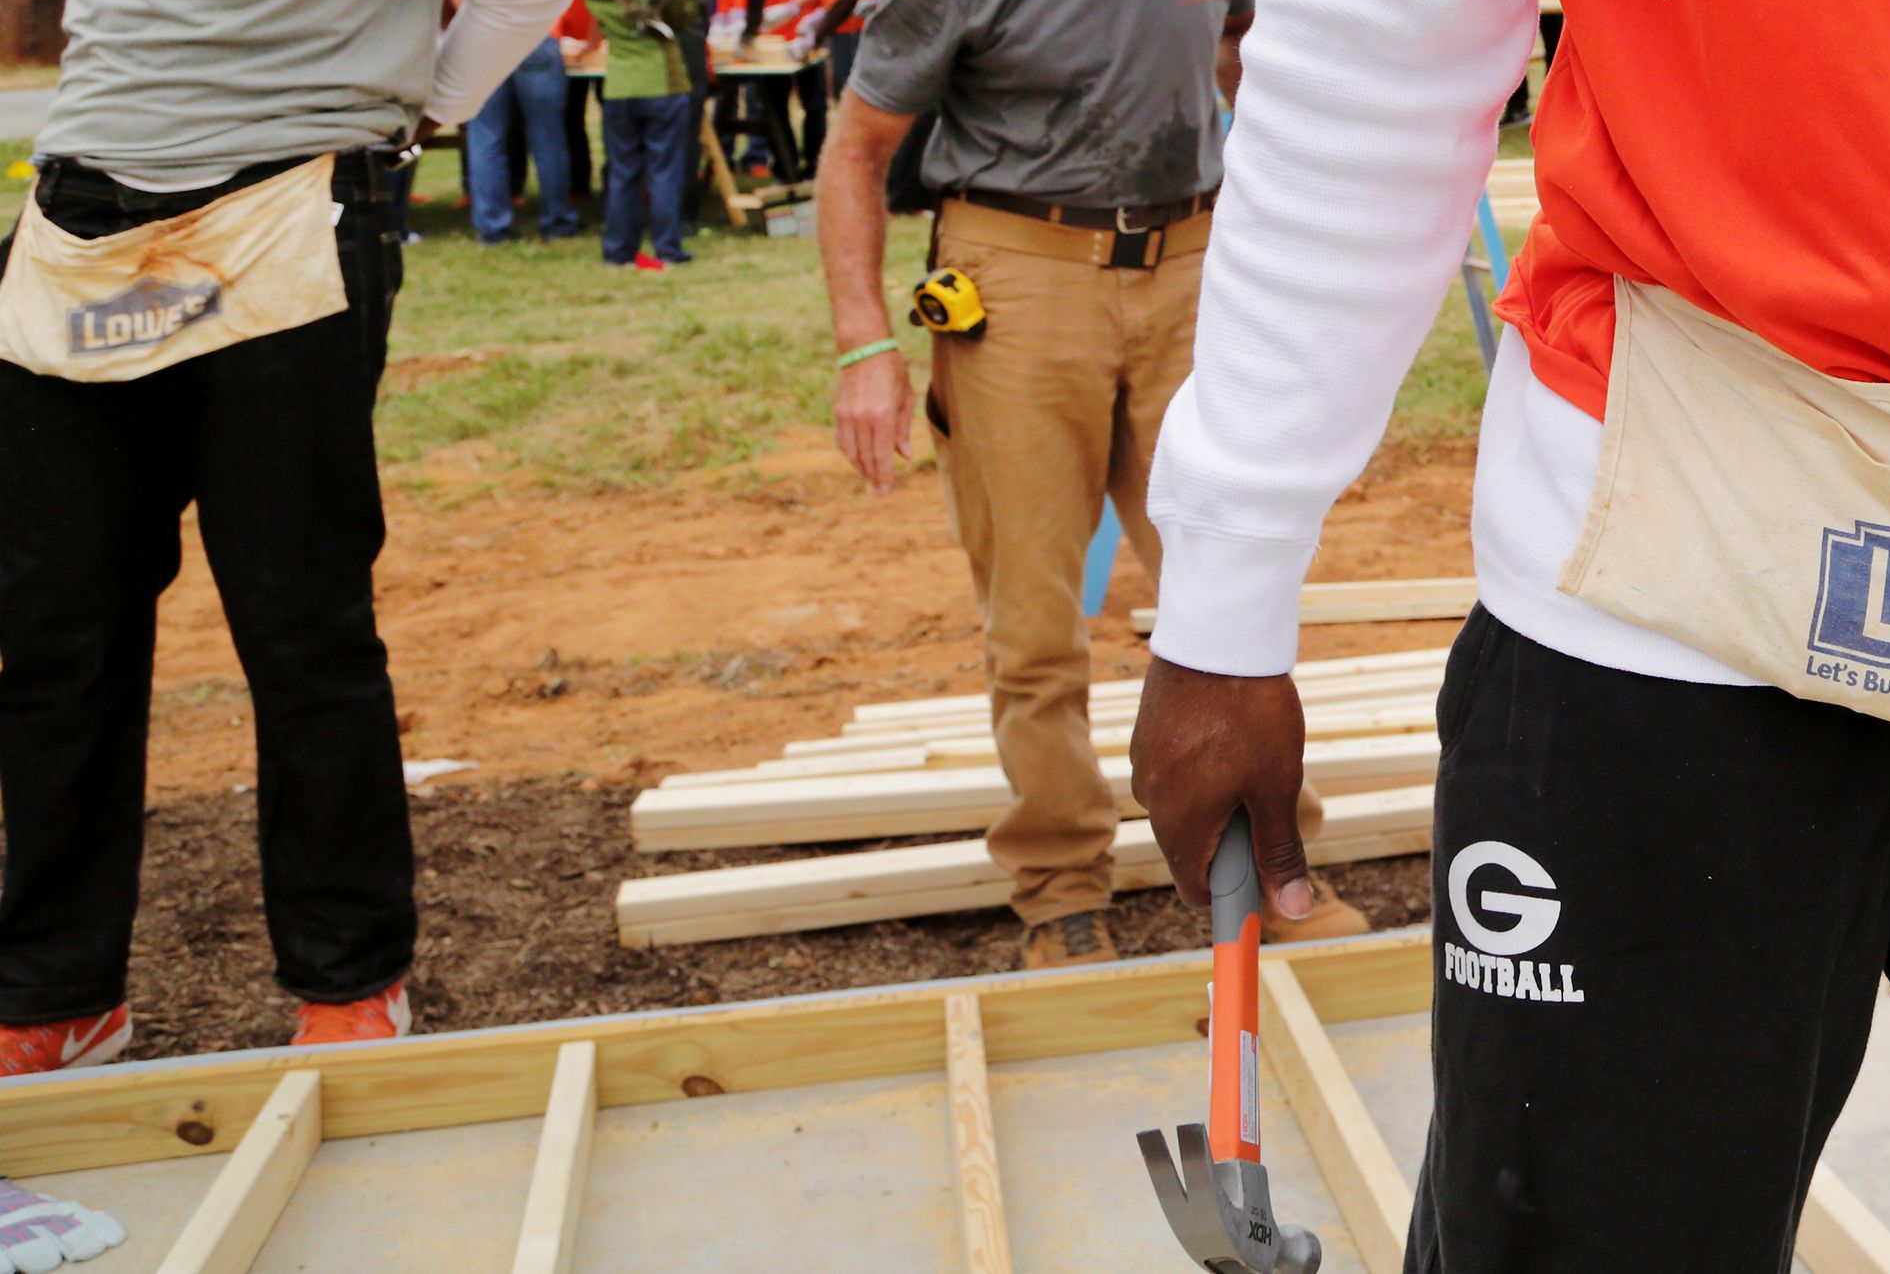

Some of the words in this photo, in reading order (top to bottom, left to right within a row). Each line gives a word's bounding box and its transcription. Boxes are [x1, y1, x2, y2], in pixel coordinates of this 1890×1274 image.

[1806, 655, 1858, 686] Let's
[1448, 840, 1561, 955] G
[1445, 942, 1584, 1002] FOOTBALL
[1248, 1220, 1272, 1246] HDX
